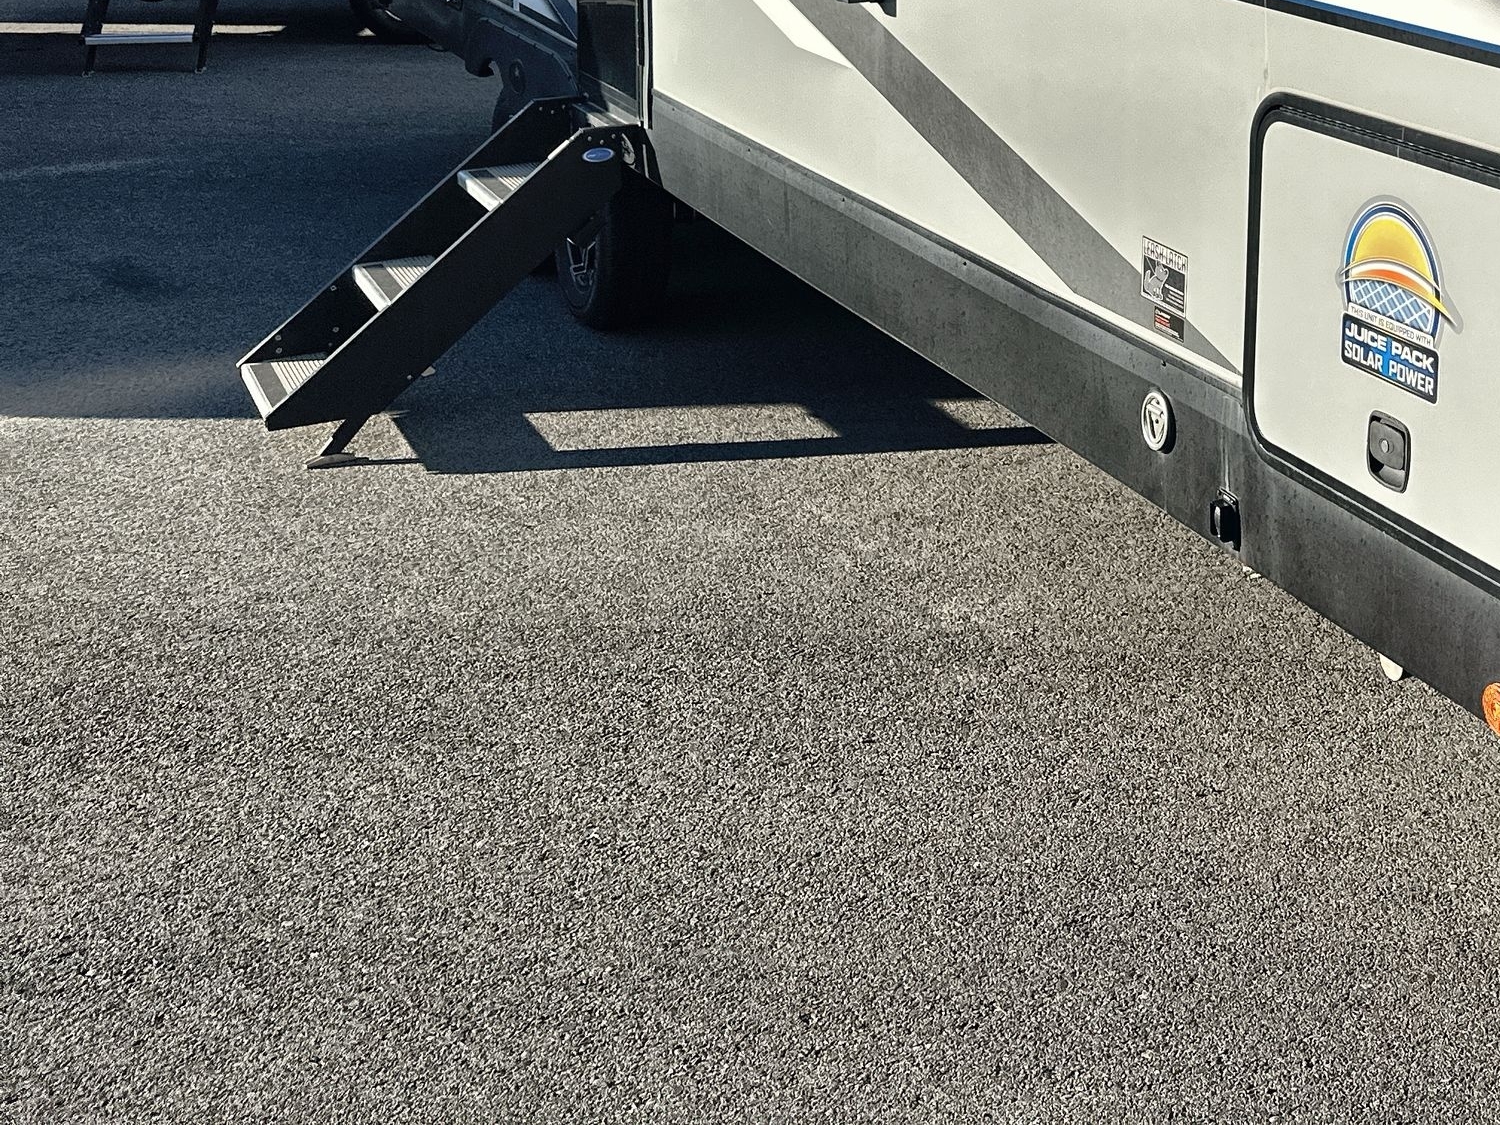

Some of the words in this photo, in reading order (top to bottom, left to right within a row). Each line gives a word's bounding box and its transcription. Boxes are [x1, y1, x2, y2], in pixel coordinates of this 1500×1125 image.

[1345, 322, 1388, 352] JUICE
[1391, 340, 1435, 373] PACK
[1351, 305, 1363, 317] THIS
[1364, 312, 1377, 323] UNIT
[1378, 318, 1385, 327] IS
[1385, 321, 1414, 339] EQUIPPED
[1416, 332, 1431, 346] WITH
[1344, 339, 1383, 372] SOLAR
[1388, 359, 1434, 396] POWER
